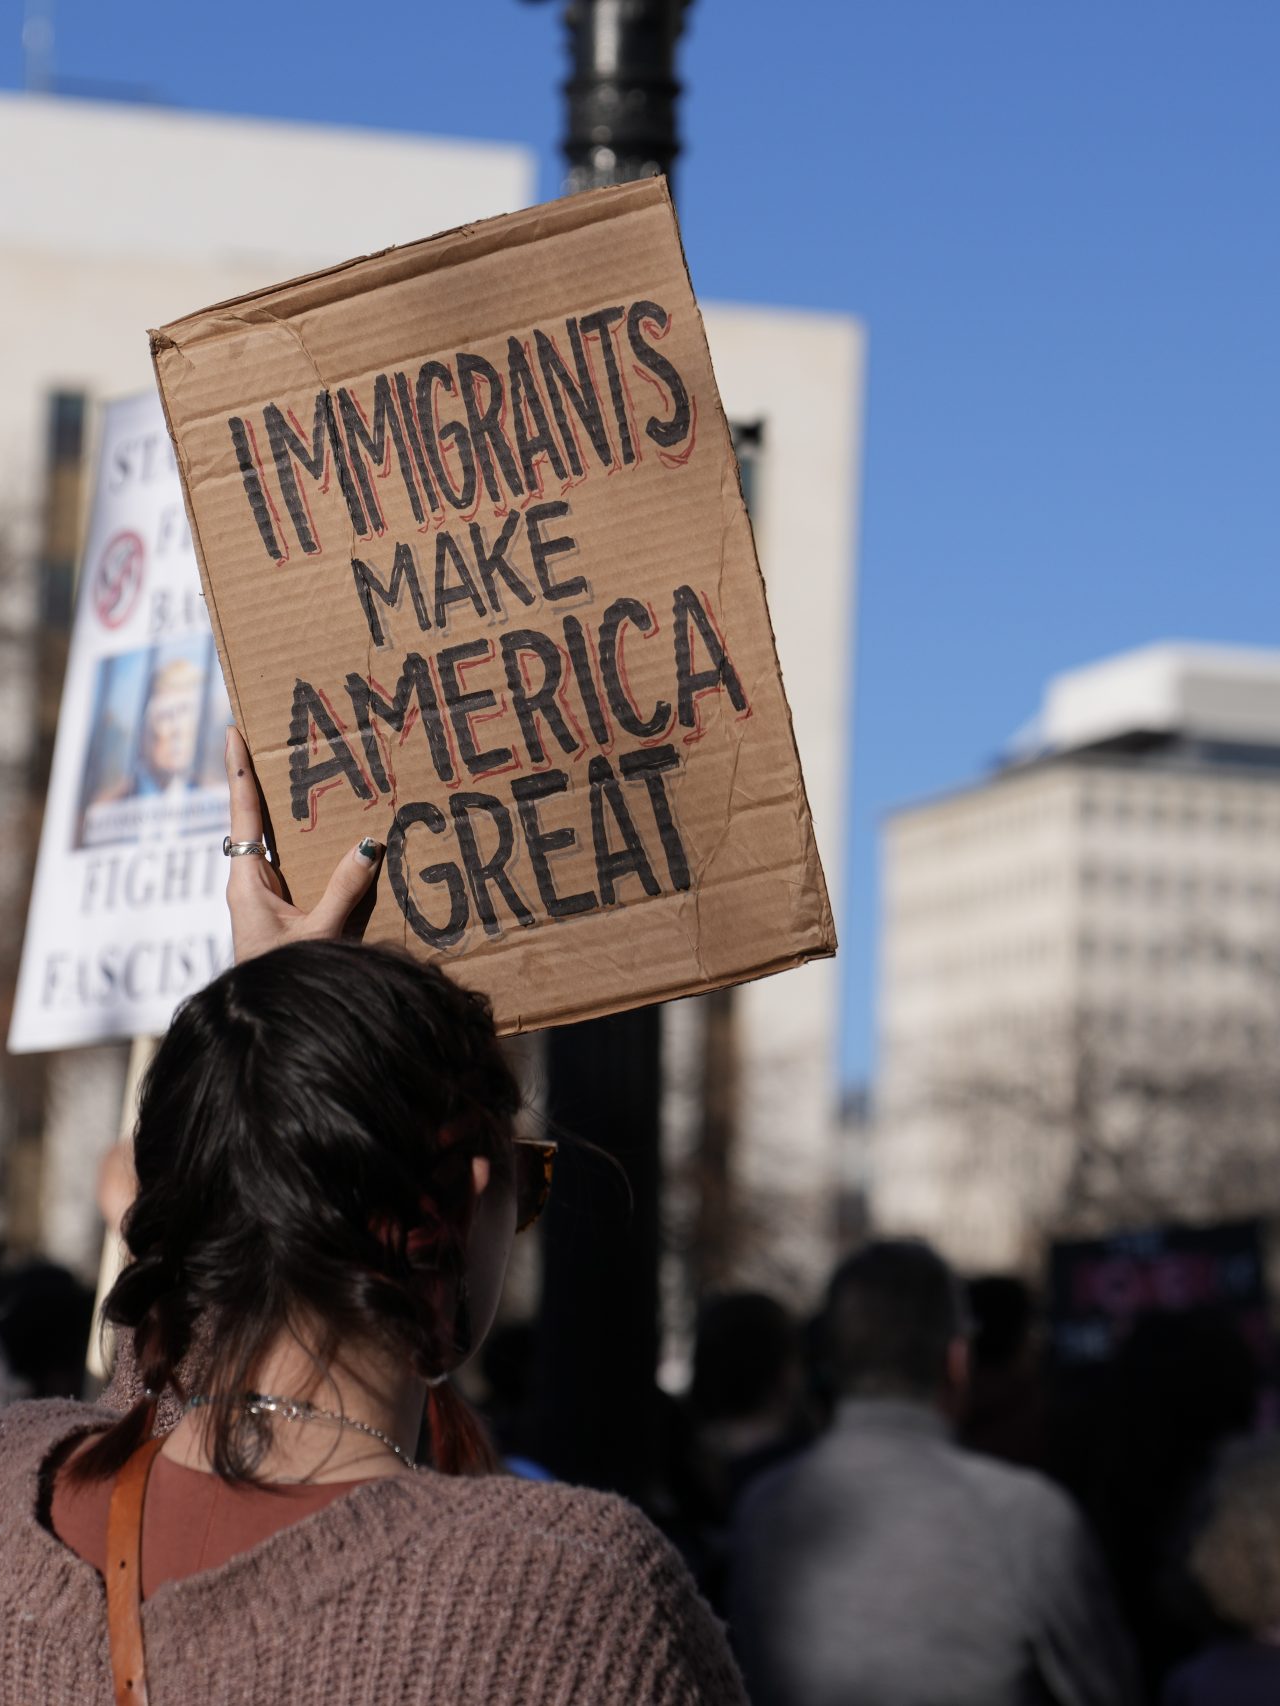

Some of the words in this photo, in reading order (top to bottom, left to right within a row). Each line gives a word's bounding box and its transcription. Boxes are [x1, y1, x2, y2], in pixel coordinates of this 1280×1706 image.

[228, 300, 698, 569] IMMIGRANTS
[350, 500, 593, 652] MAKE
[286, 584, 752, 833] AMERICA
[80, 844, 224, 916] FIGHT
[385, 743, 692, 952] GREAT
